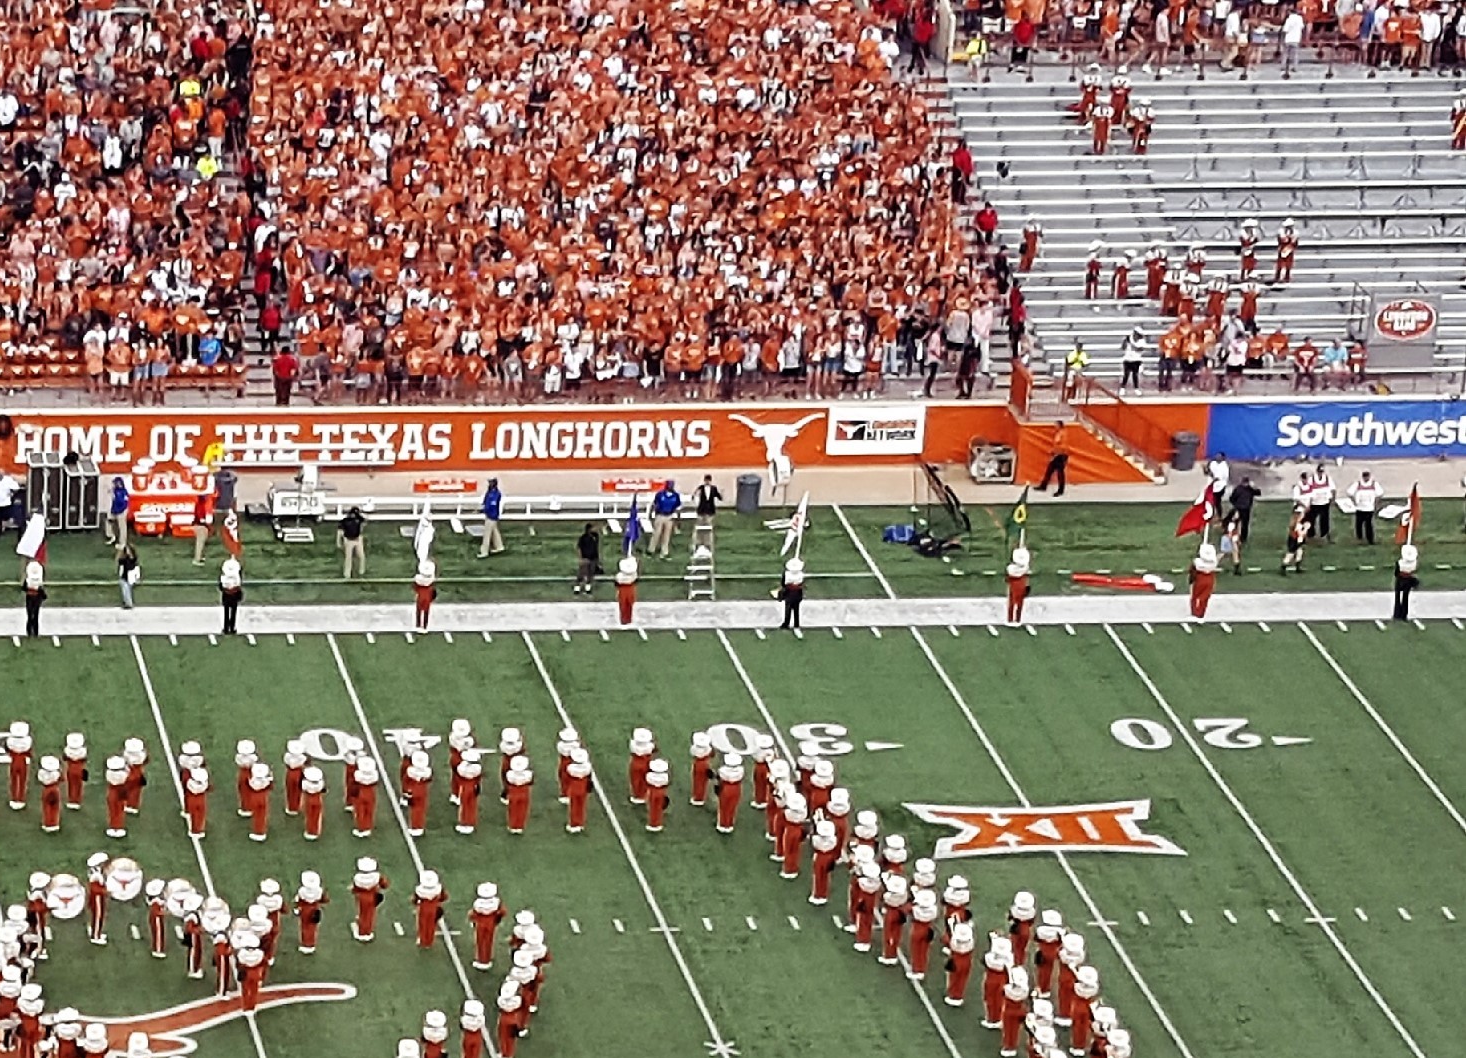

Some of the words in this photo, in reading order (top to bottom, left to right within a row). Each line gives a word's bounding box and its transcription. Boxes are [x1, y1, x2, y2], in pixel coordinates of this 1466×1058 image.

[14, 424, 132, 463] HOME
[149, 424, 201, 463] OF
[215, 424, 301, 461] THE
[312, 423, 452, 461] TEXAS
[468, 420, 712, 459] LONGHORNS
[1276, 412, 1466, 446] Southwest
